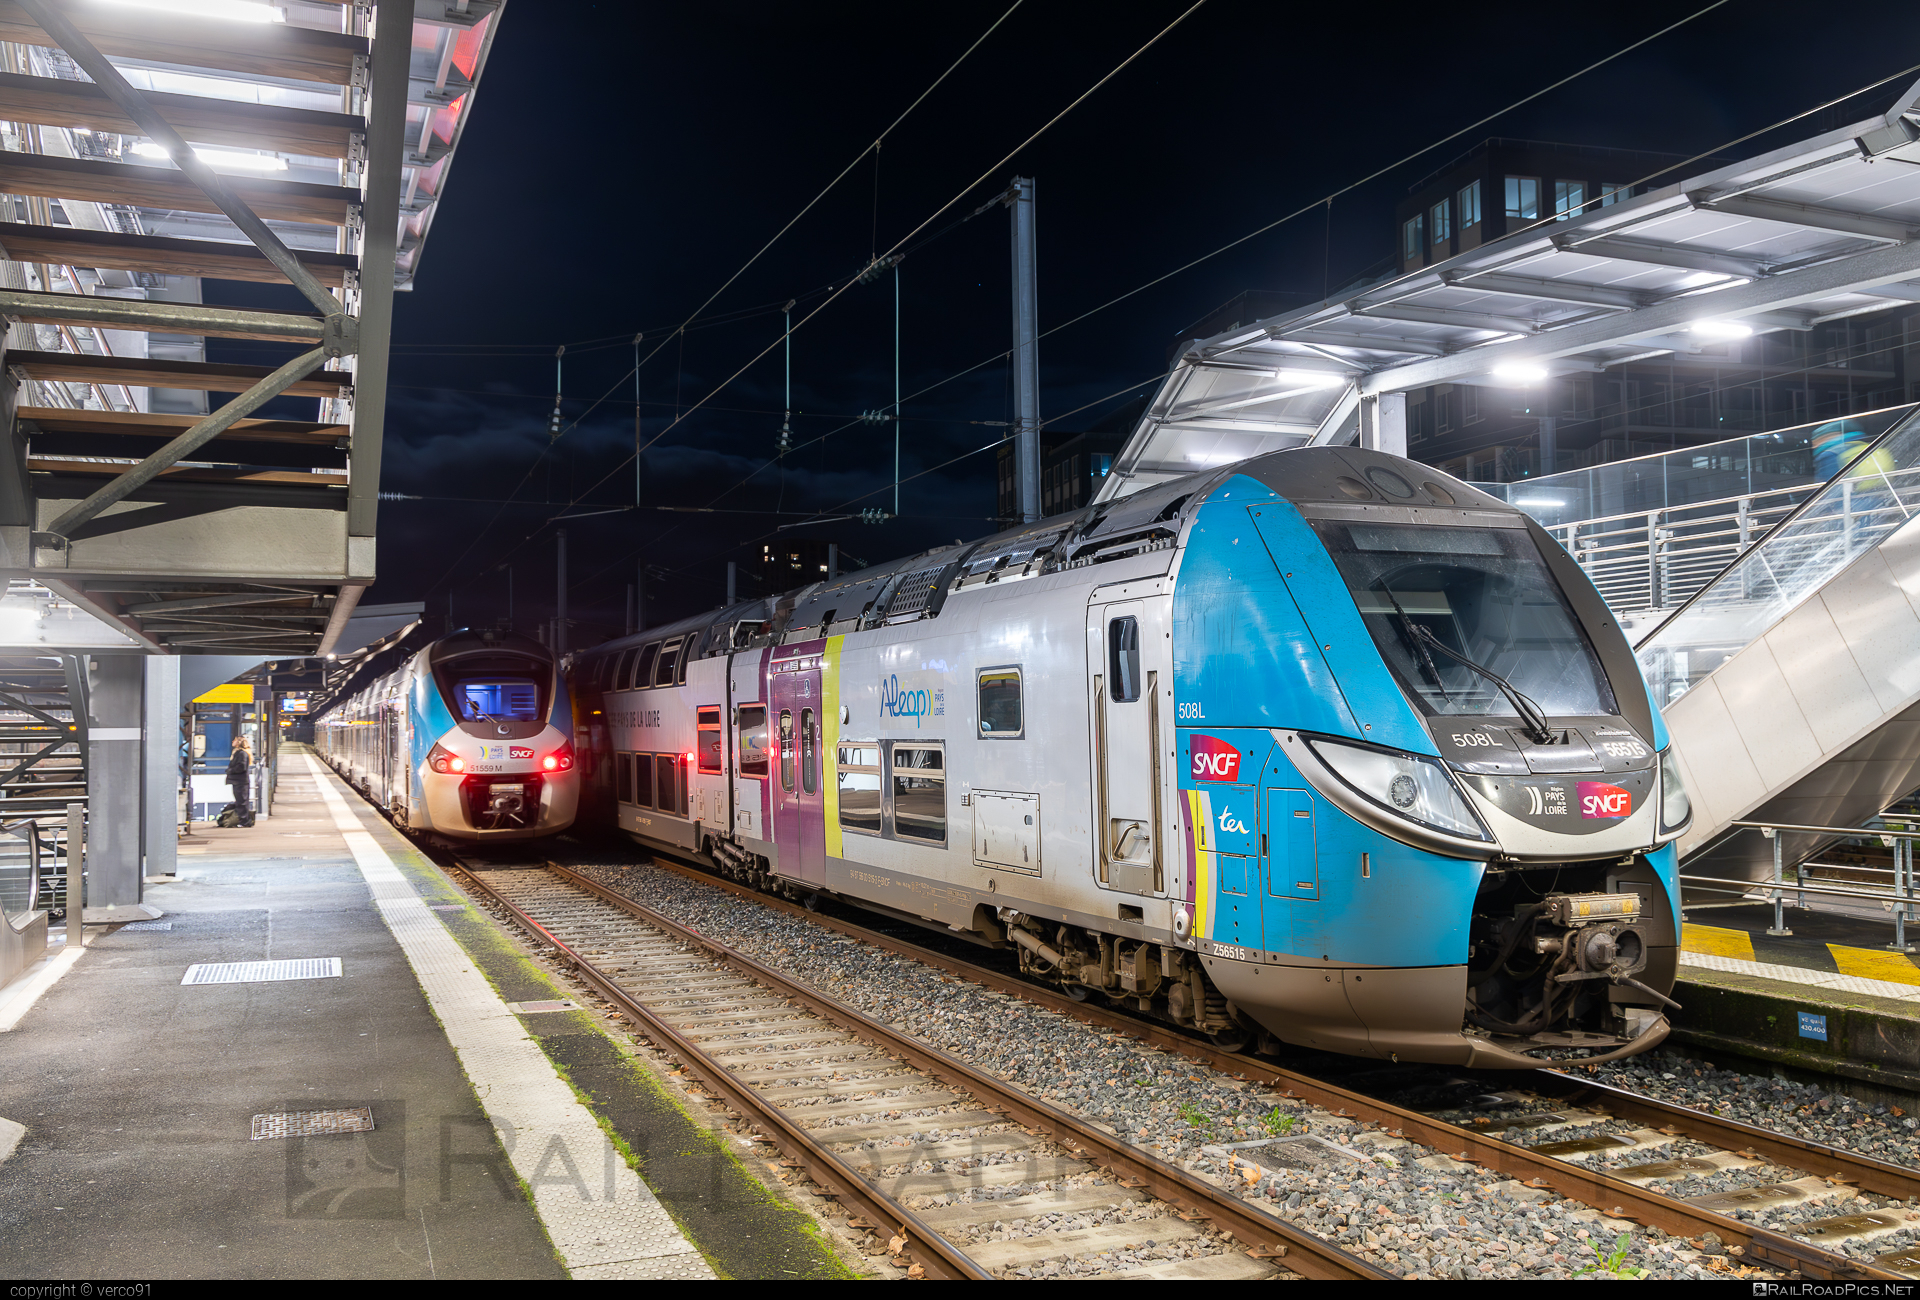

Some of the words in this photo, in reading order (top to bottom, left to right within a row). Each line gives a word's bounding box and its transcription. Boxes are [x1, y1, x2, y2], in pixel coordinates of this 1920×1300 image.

[934, 693, 945, 702] PAYS
[637, 710, 644, 728] LA
[645, 709, 660, 728] LOIRE
[1178, 702, 1206, 719] 508L
[815, 724, 821, 741] 2
[1451, 732, 1504, 748] 508L
[510, 750, 534, 758] SNCF
[1602, 741, 1647, 757] 56515
[469, 764, 494, 772] 51559
[1192, 752, 1238, 776] SNCF
[1544, 791, 1566, 801] PAYS
[1582, 793, 1628, 815] SNCF
[1544, 805, 1568, 815] LOIRE
[1212, 942, 1246, 961] Z56515
